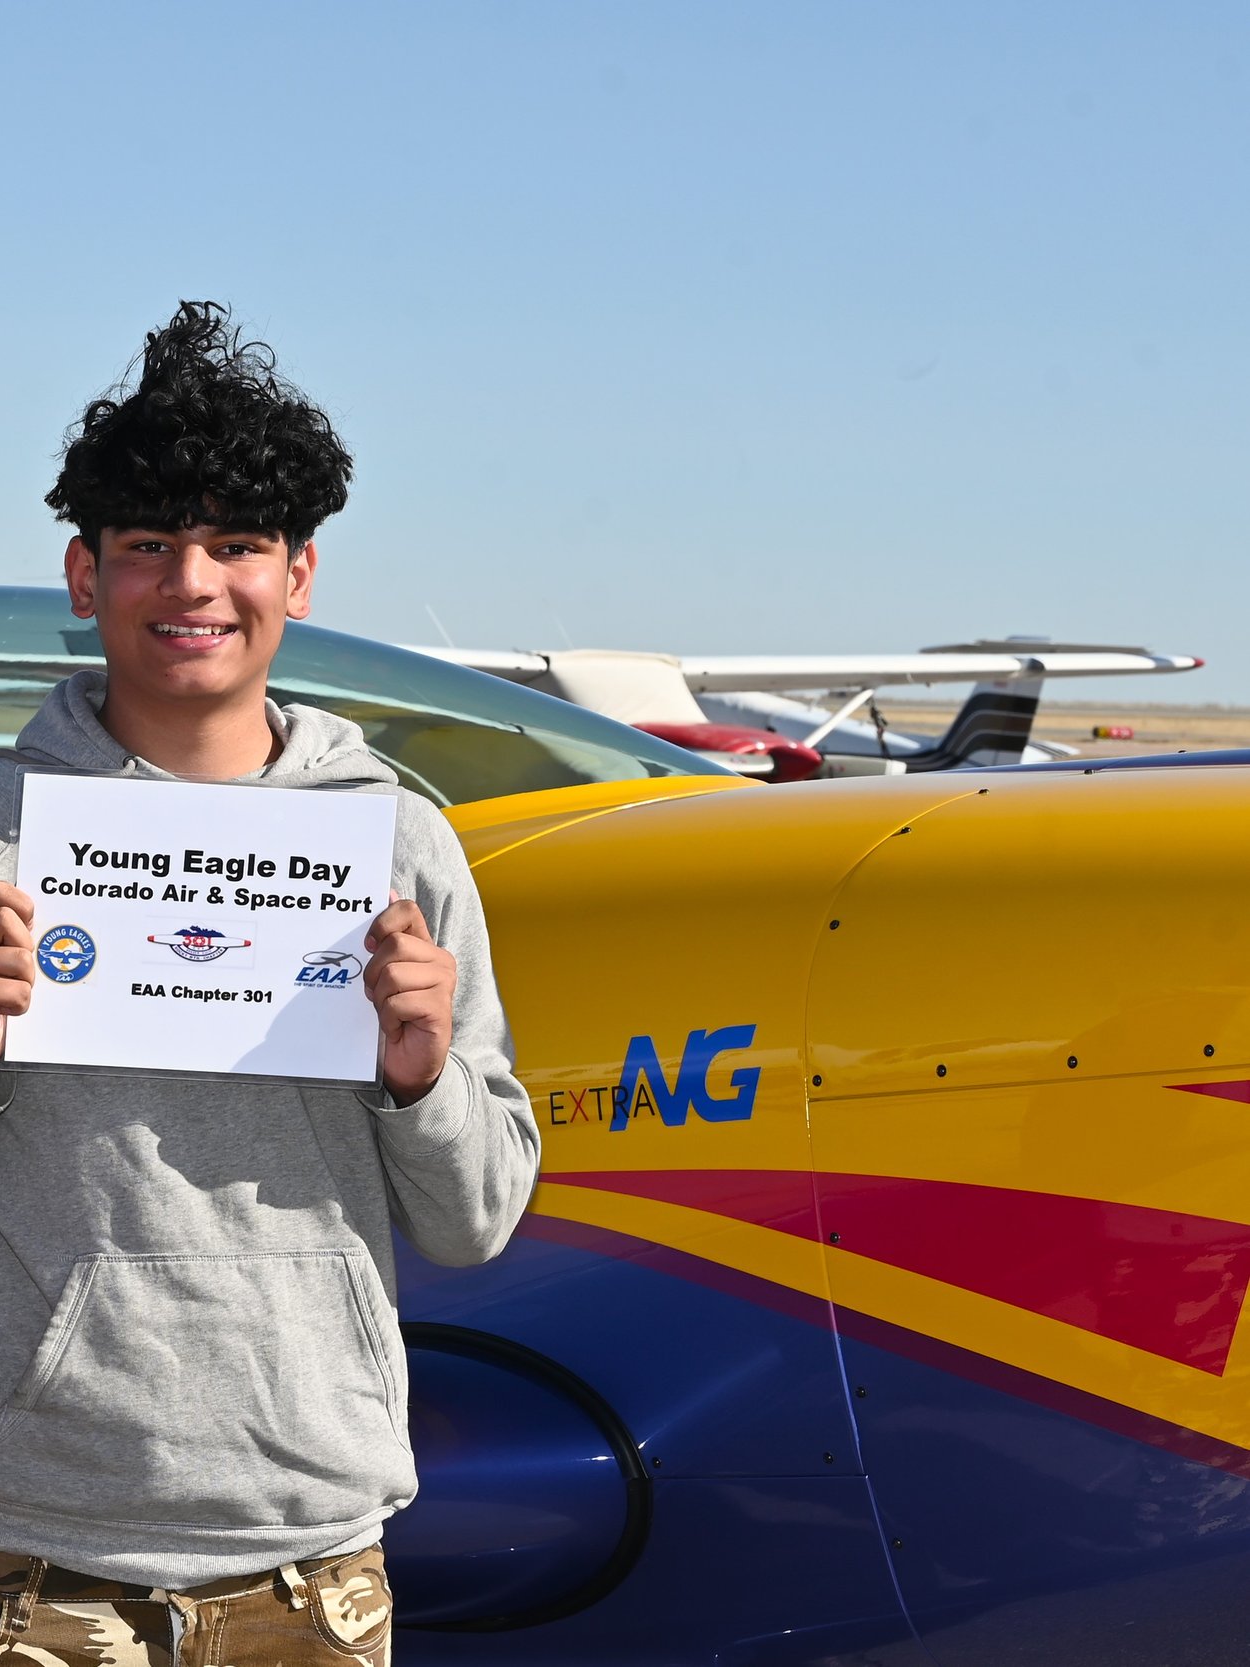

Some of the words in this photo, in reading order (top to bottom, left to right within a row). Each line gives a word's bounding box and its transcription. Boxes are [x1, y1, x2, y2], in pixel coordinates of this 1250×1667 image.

[68, 842, 171, 878] Young
[183, 849, 277, 882] Eagle
[288, 855, 352, 888] Day
[40, 876, 154, 900] Colorado
[161, 883, 199, 903] Air
[206, 886, 225, 905] &
[233, 887, 312, 911] Space
[320, 893, 373, 914] Port
[42, 928, 67, 946] YOUNG
[68, 928, 91, 949] EAGLES
[295, 966, 349, 984] EAA
[131, 983, 166, 997] EAA
[171, 985, 239, 1002] Chapter
[243, 989, 273, 1003] 301
[549, 1083, 655, 1126] EXTRA
[608, 1023, 762, 1132] NG
